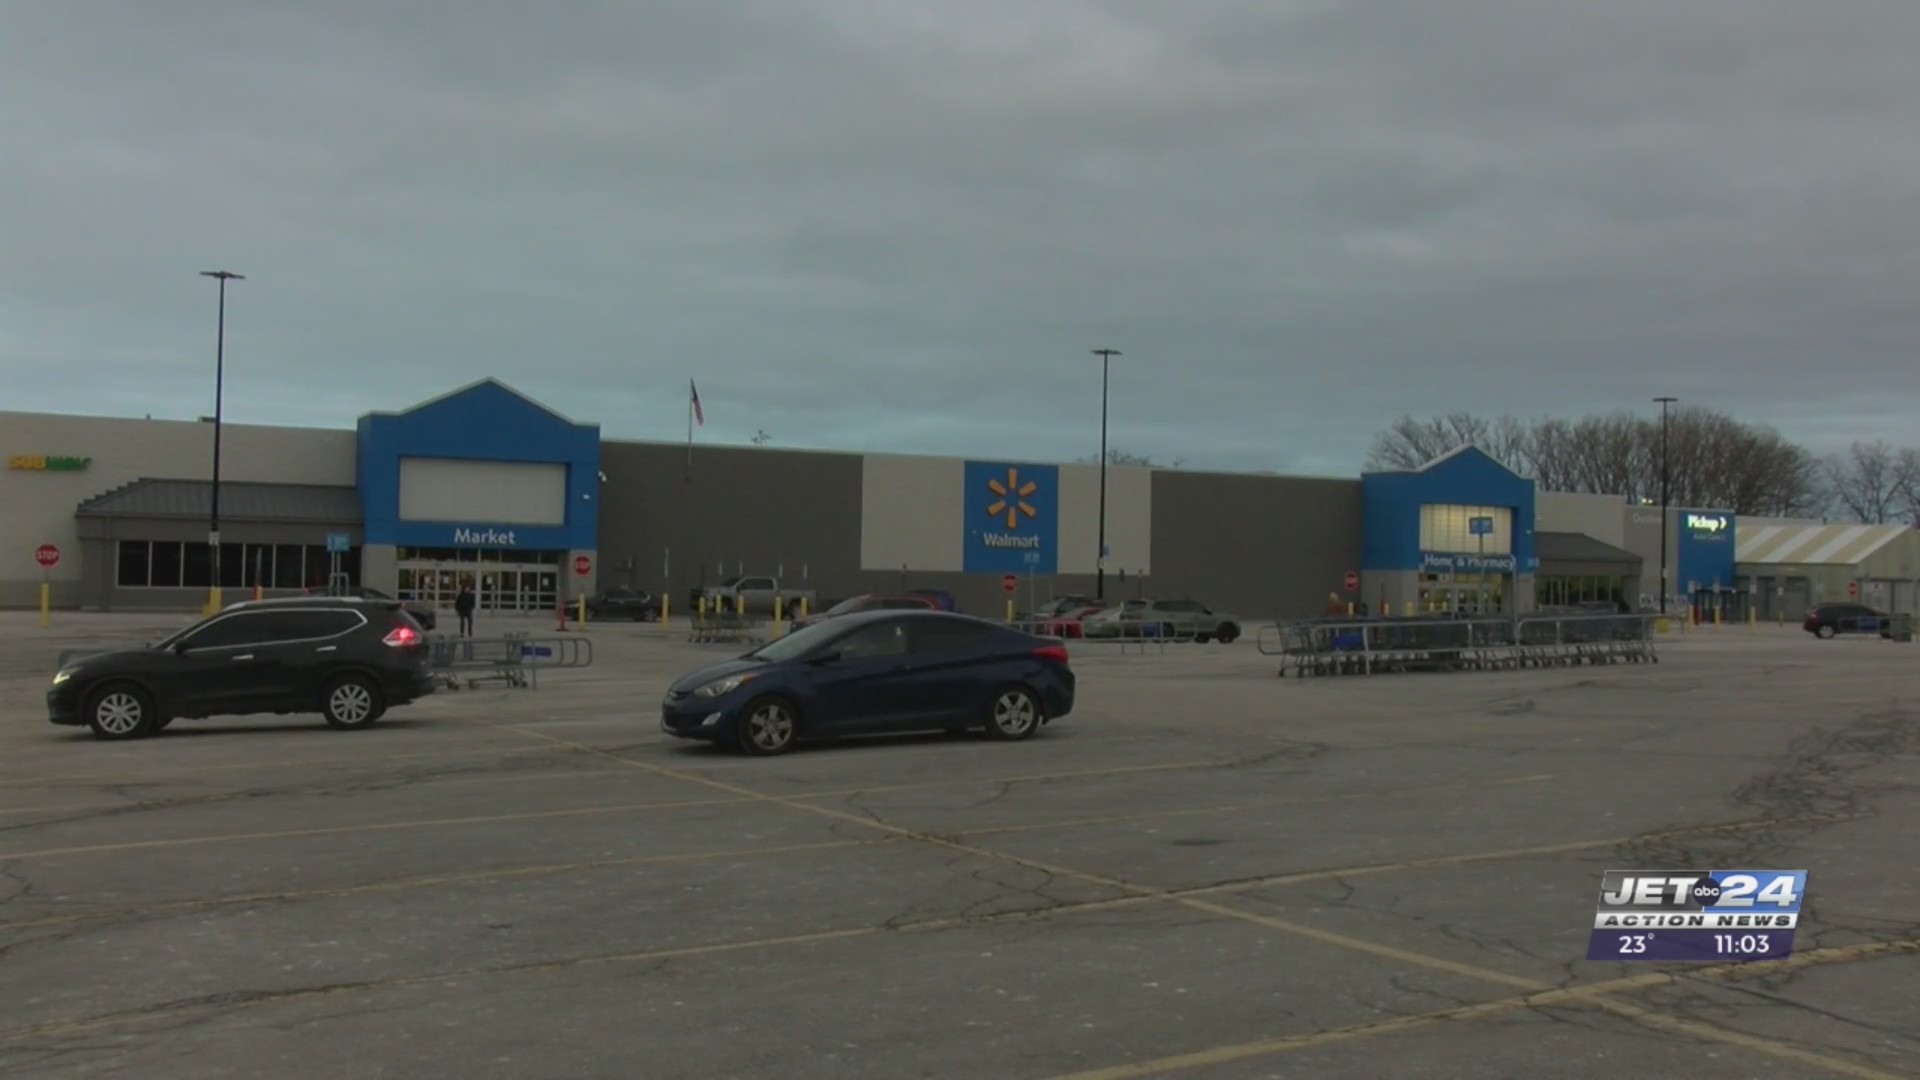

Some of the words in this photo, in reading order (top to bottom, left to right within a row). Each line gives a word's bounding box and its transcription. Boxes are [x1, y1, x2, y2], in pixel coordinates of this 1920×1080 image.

[8, 455, 91, 470] SUBWAY
[1687, 514, 1719, 532] Pickup
[454, 528, 516, 545] Market
[983, 532, 1040, 548] Walmart
[36, 550, 58, 561] STOP
[1424, 554, 1453, 566] Home
